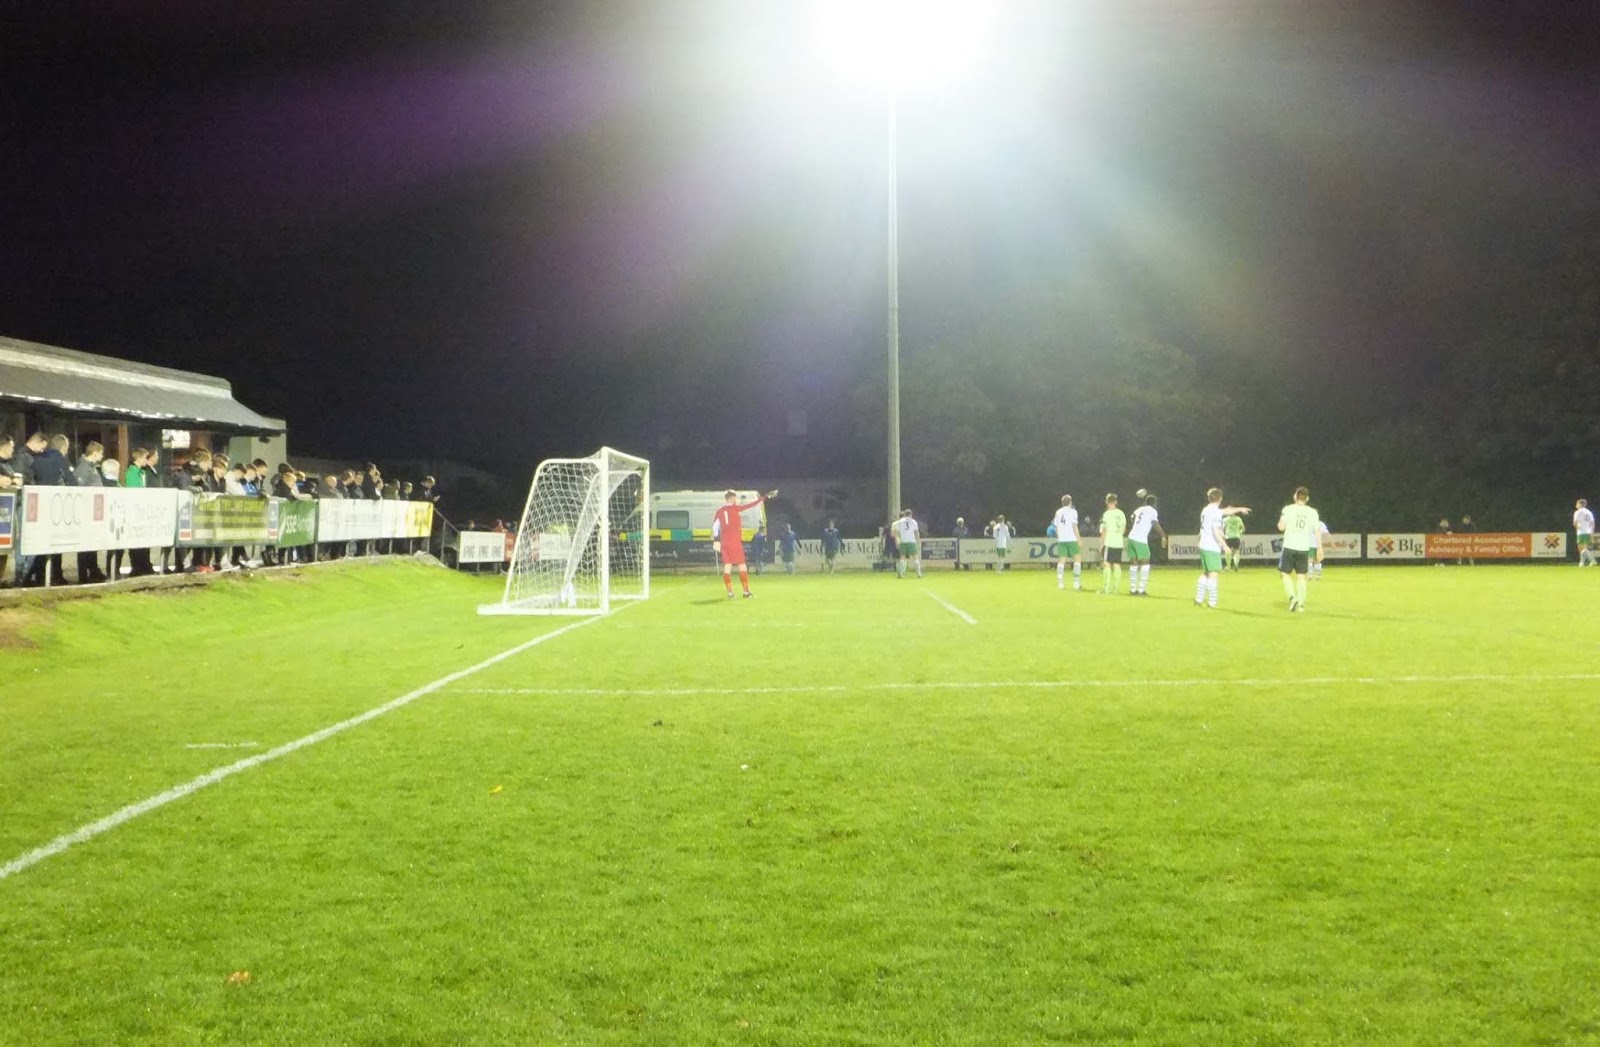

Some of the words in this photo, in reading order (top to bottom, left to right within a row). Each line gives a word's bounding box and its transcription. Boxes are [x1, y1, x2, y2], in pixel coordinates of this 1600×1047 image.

[724, 510, 729, 524] 1
[1060, 515, 1066, 525] 4
[903, 521, 910, 531] 3
[1433, 536, 1472, 544] Chartered
[1474, 536, 1523, 544] Accountants
[1398, 538, 1423, 555] Blg
[1429, 546, 1464, 554] Advisory
[1474, 546, 1500, 554] Family
